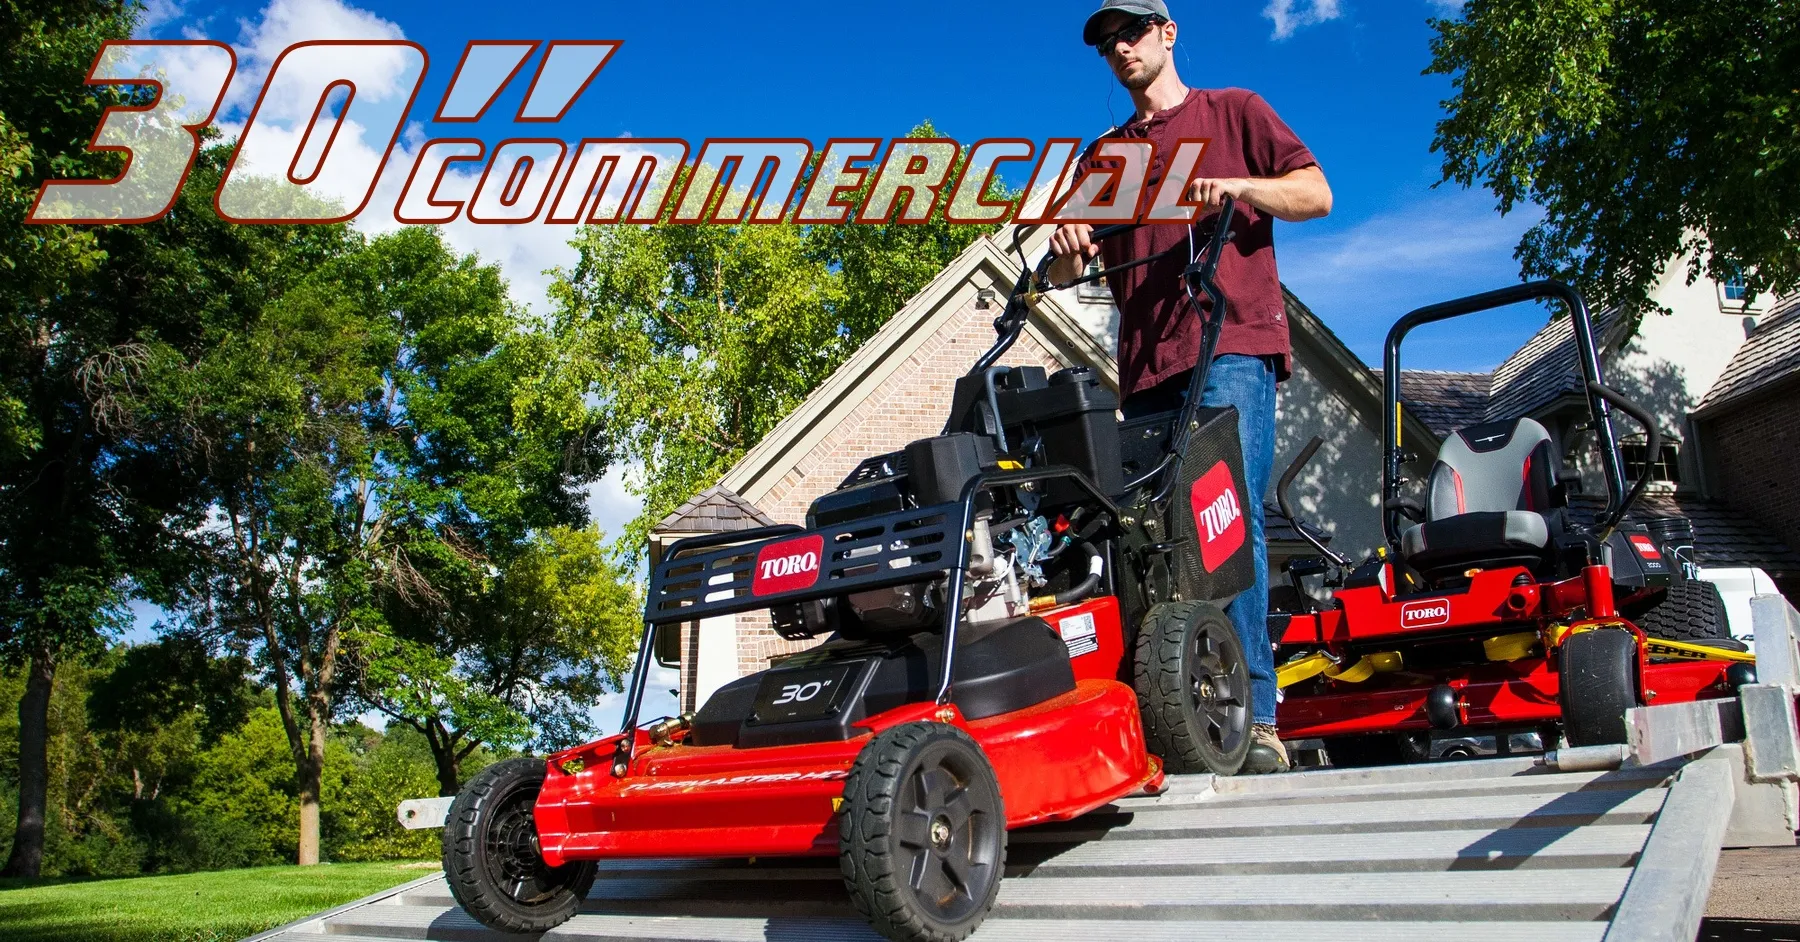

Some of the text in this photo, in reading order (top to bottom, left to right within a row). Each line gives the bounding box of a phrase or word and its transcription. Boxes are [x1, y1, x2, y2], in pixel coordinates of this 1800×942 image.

[1200, 488, 1240, 543] TORO
[761, 551, 818, 580] TORO
[1405, 606, 1447, 621] TORO
[772, 680, 832, 705] 30"
